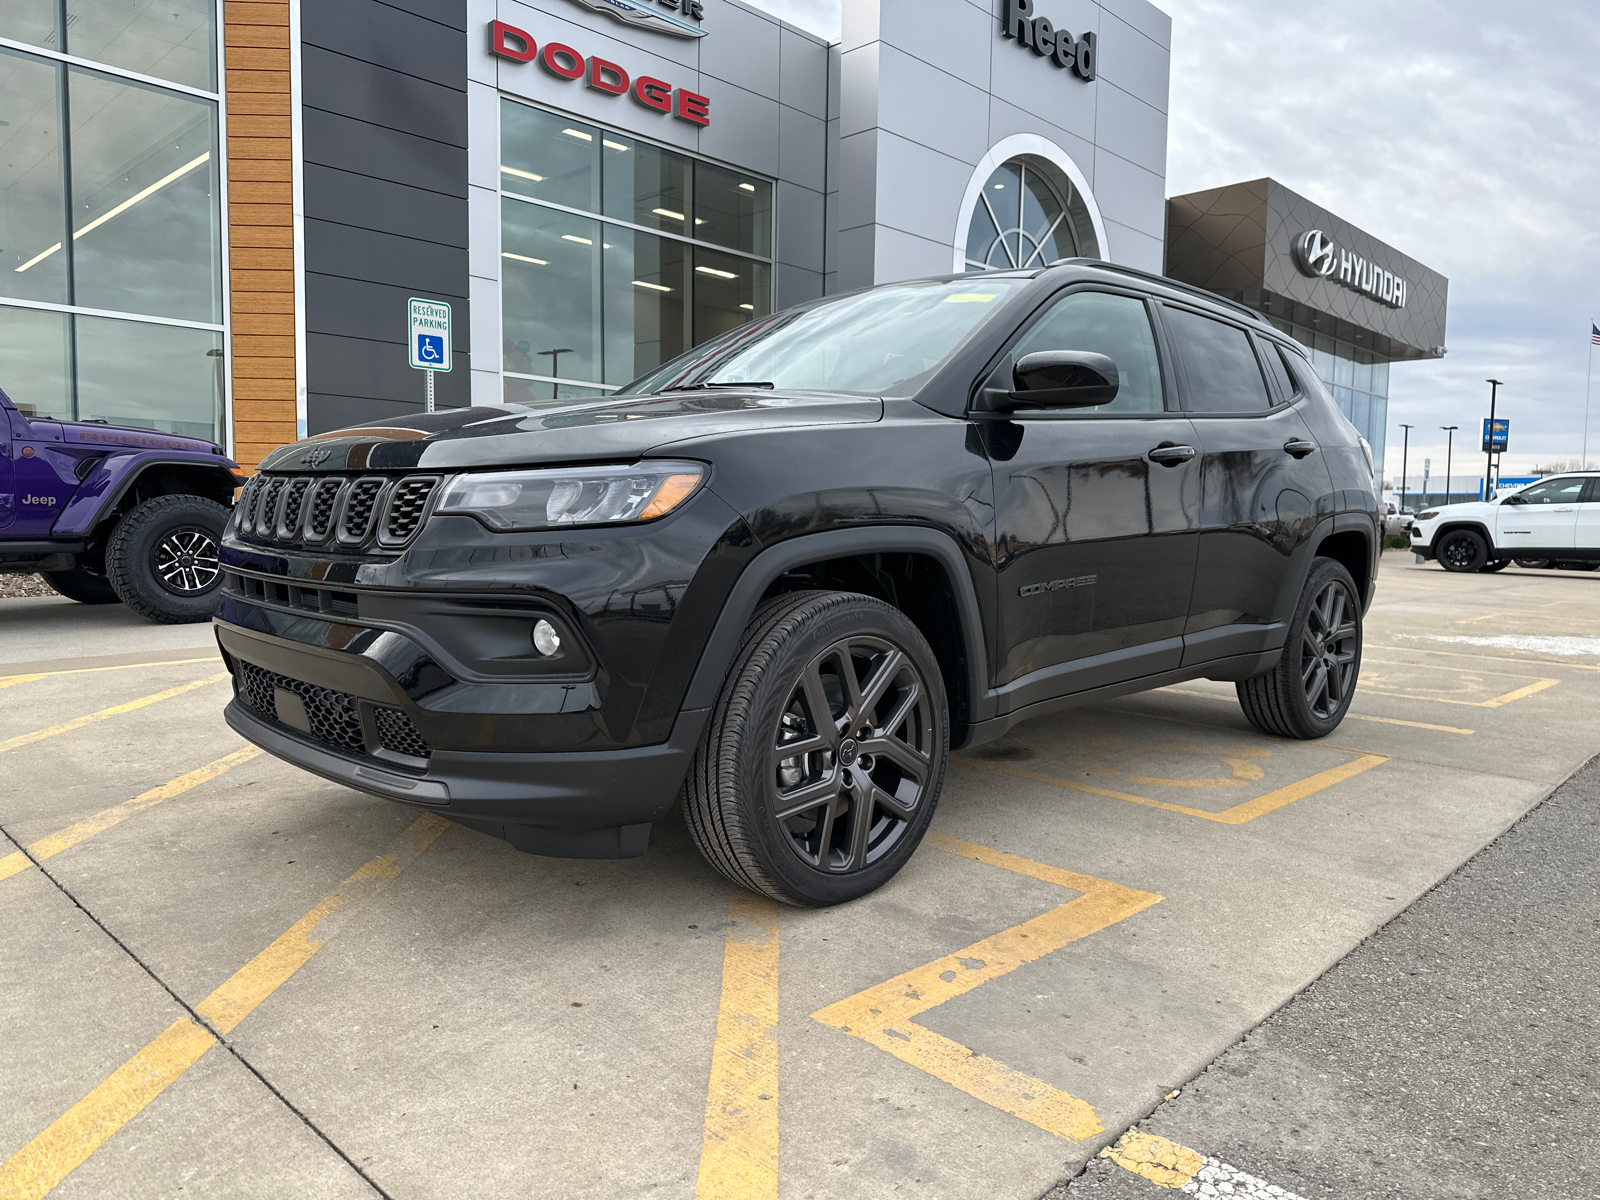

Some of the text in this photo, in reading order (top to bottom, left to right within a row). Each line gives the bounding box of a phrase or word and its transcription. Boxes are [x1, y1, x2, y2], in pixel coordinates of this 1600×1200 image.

[1002, 0, 1097, 82] Reed
[488, 20, 709, 127] DODGE
[1340, 248, 1406, 308] HYUNDAI
[413, 305, 447, 319] RESERVED
[413, 317, 447, 331] PARKING
[78, 432, 201, 451] RUBICON
[22, 494, 57, 506] Jeep
[1018, 574, 1097, 596] COMPASS
[813, 612, 857, 641] Continental
